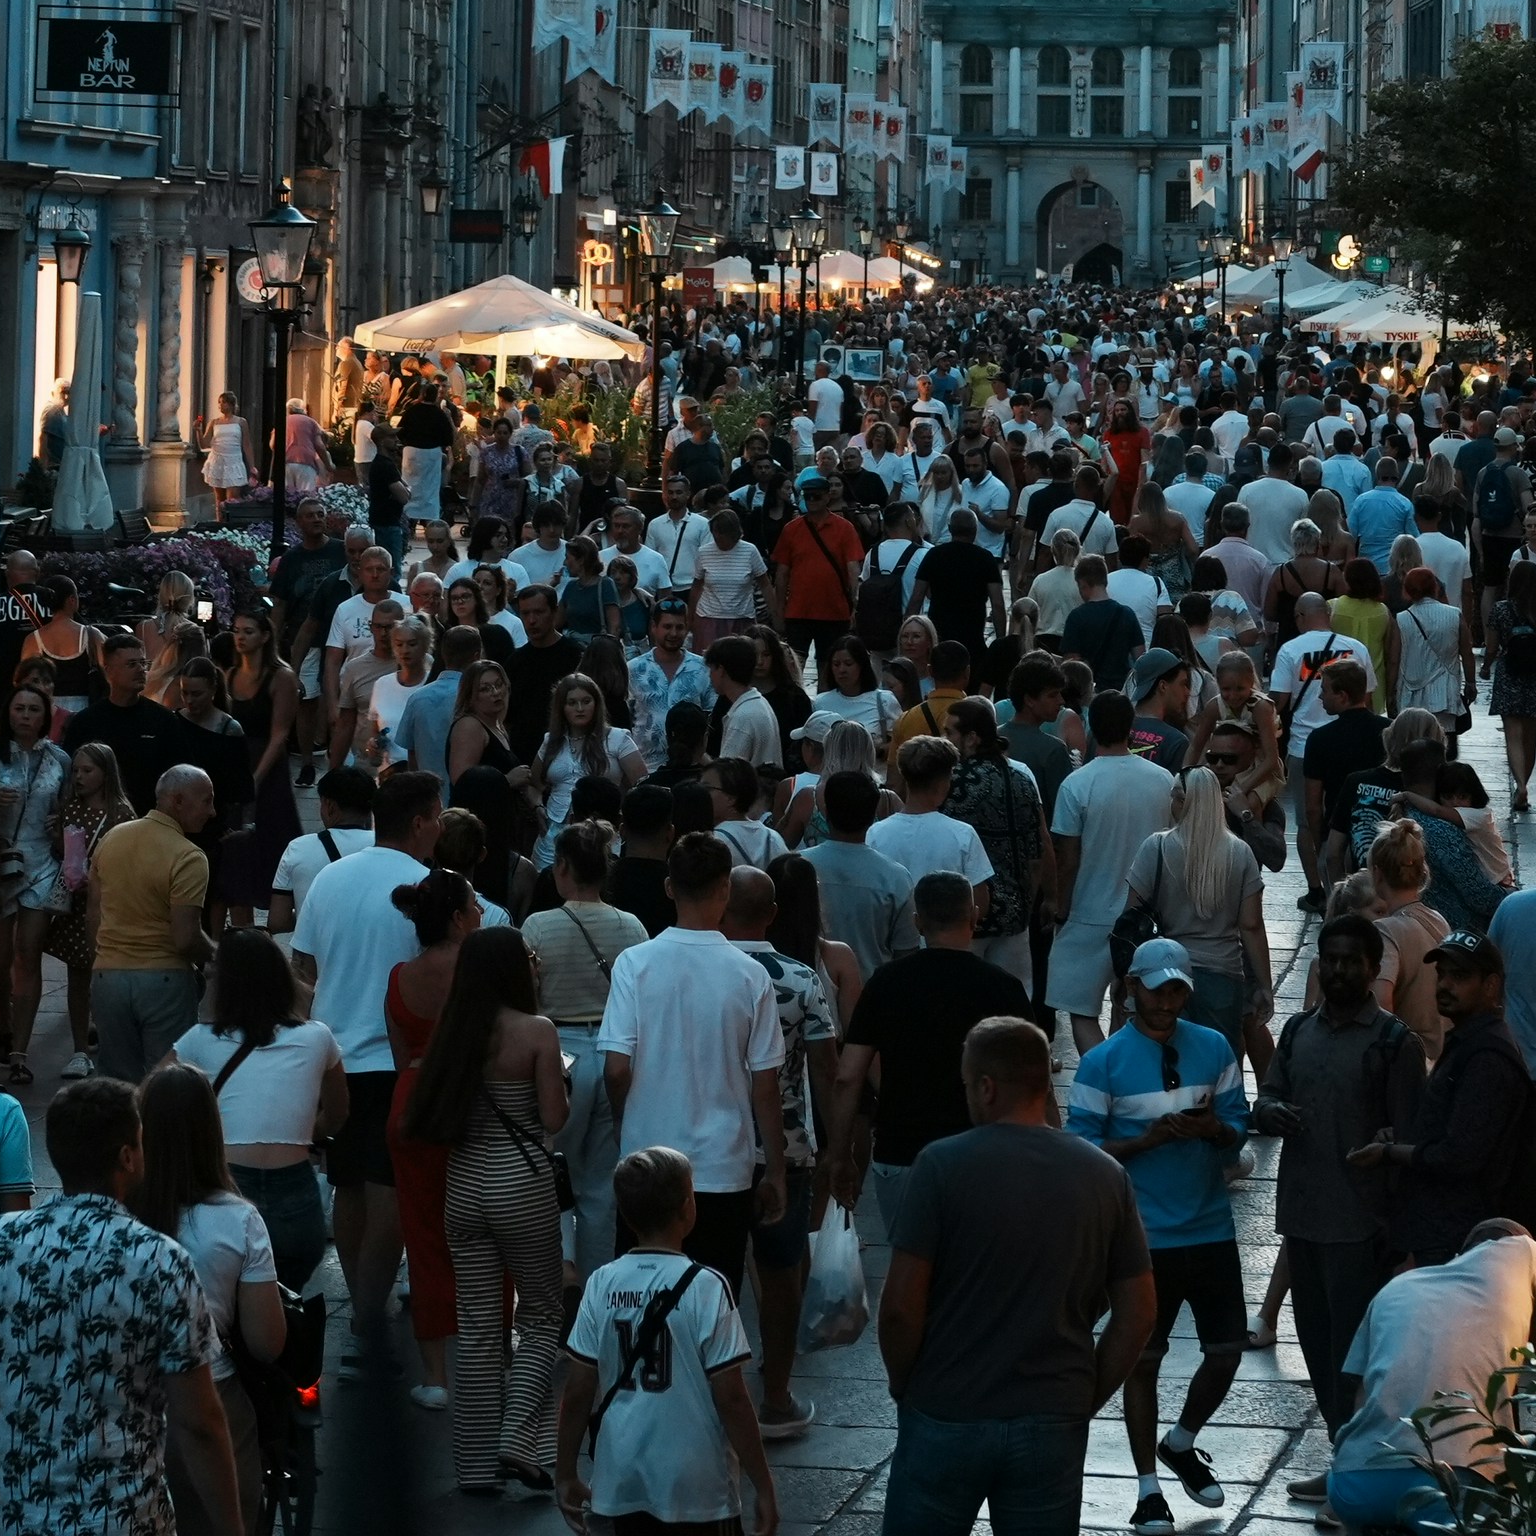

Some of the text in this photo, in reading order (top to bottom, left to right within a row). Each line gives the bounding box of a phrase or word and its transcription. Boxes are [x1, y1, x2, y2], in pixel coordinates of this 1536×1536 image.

[88, 56, 130, 73] NEPTUN
[80, 73, 136, 89] BAR
[1385, 332, 1421, 341] TYSKIE
[1356, 782, 1386, 799] SYSTEM
